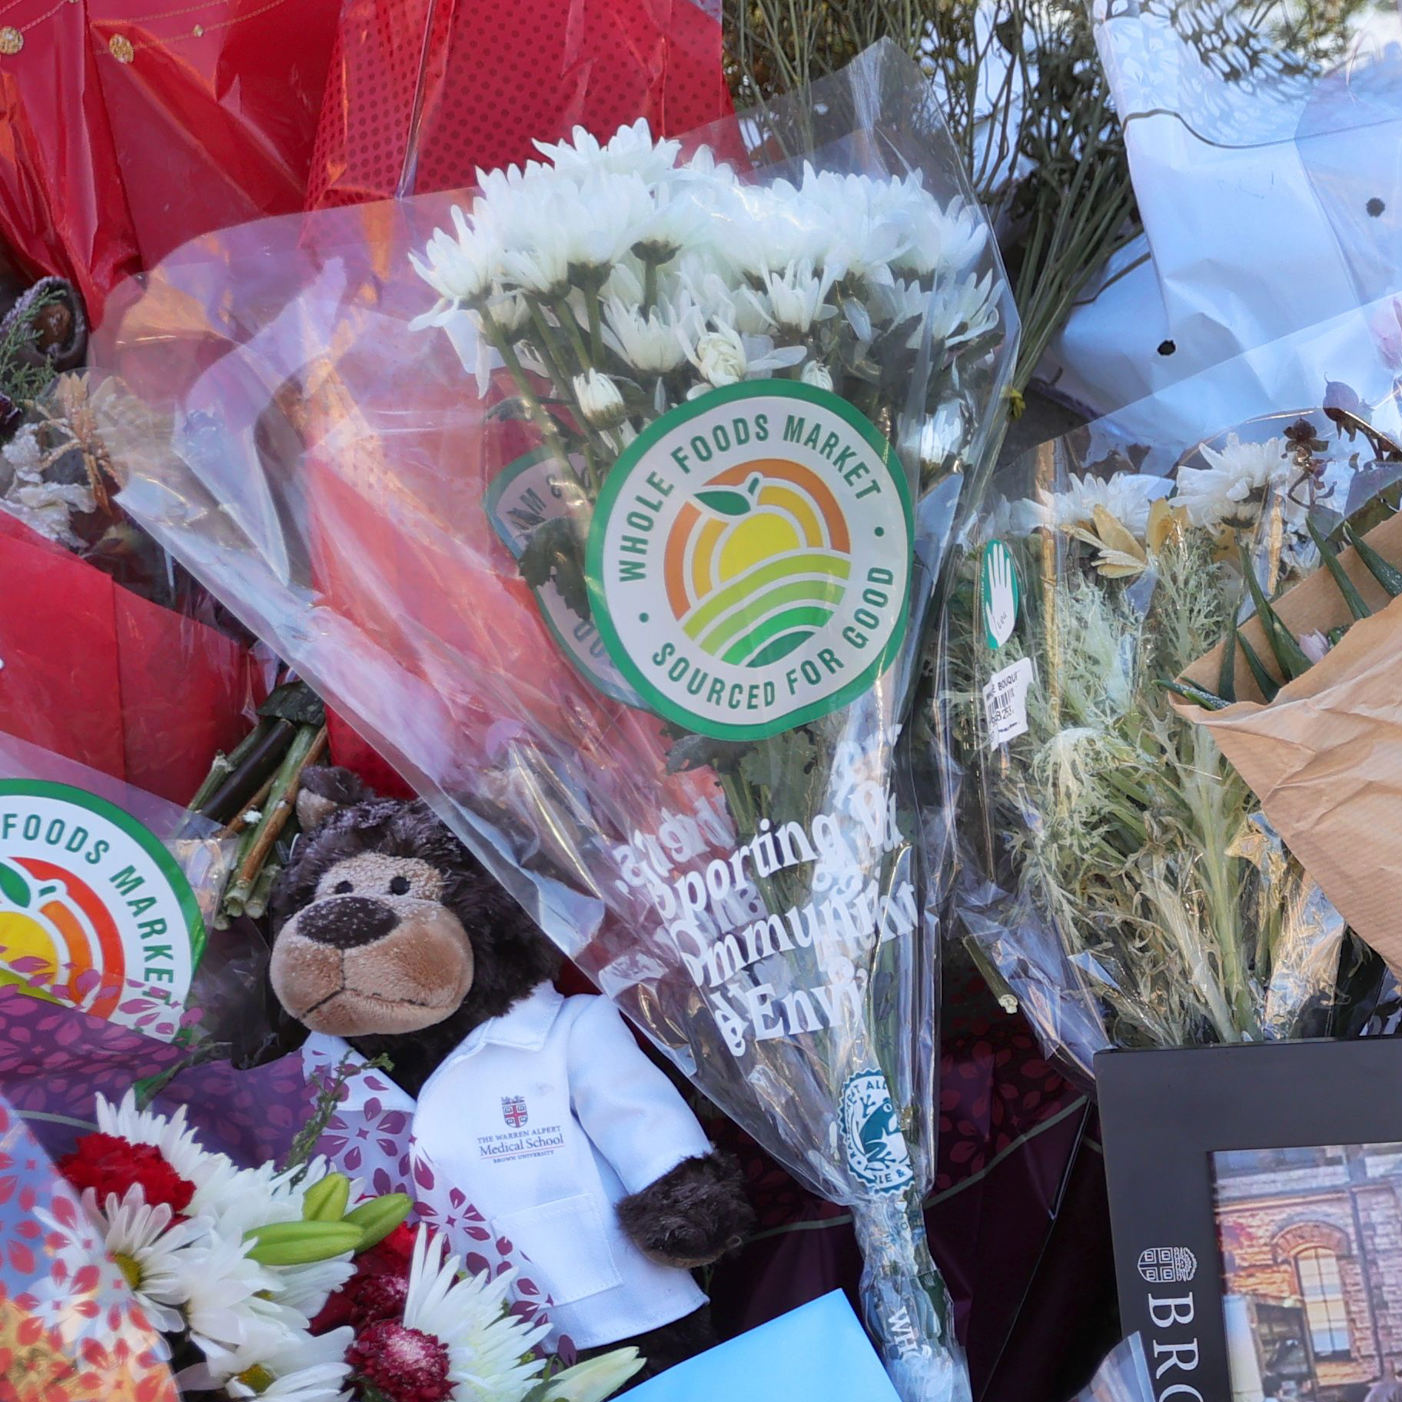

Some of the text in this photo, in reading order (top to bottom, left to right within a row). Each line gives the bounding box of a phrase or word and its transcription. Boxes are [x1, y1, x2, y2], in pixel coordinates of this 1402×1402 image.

[619, 471, 675, 582] WHOLE
[670, 414, 770, 475] FOODS
[783, 415, 882, 499] MARKET
[652, 567, 894, 710] SOURCED FOR GOOD
[2, 813, 173, 1006] FOODS MARKET
[477, 1125, 560, 1144] THE WARREN ALPERT
[479, 1133, 564, 1156] Medical School
